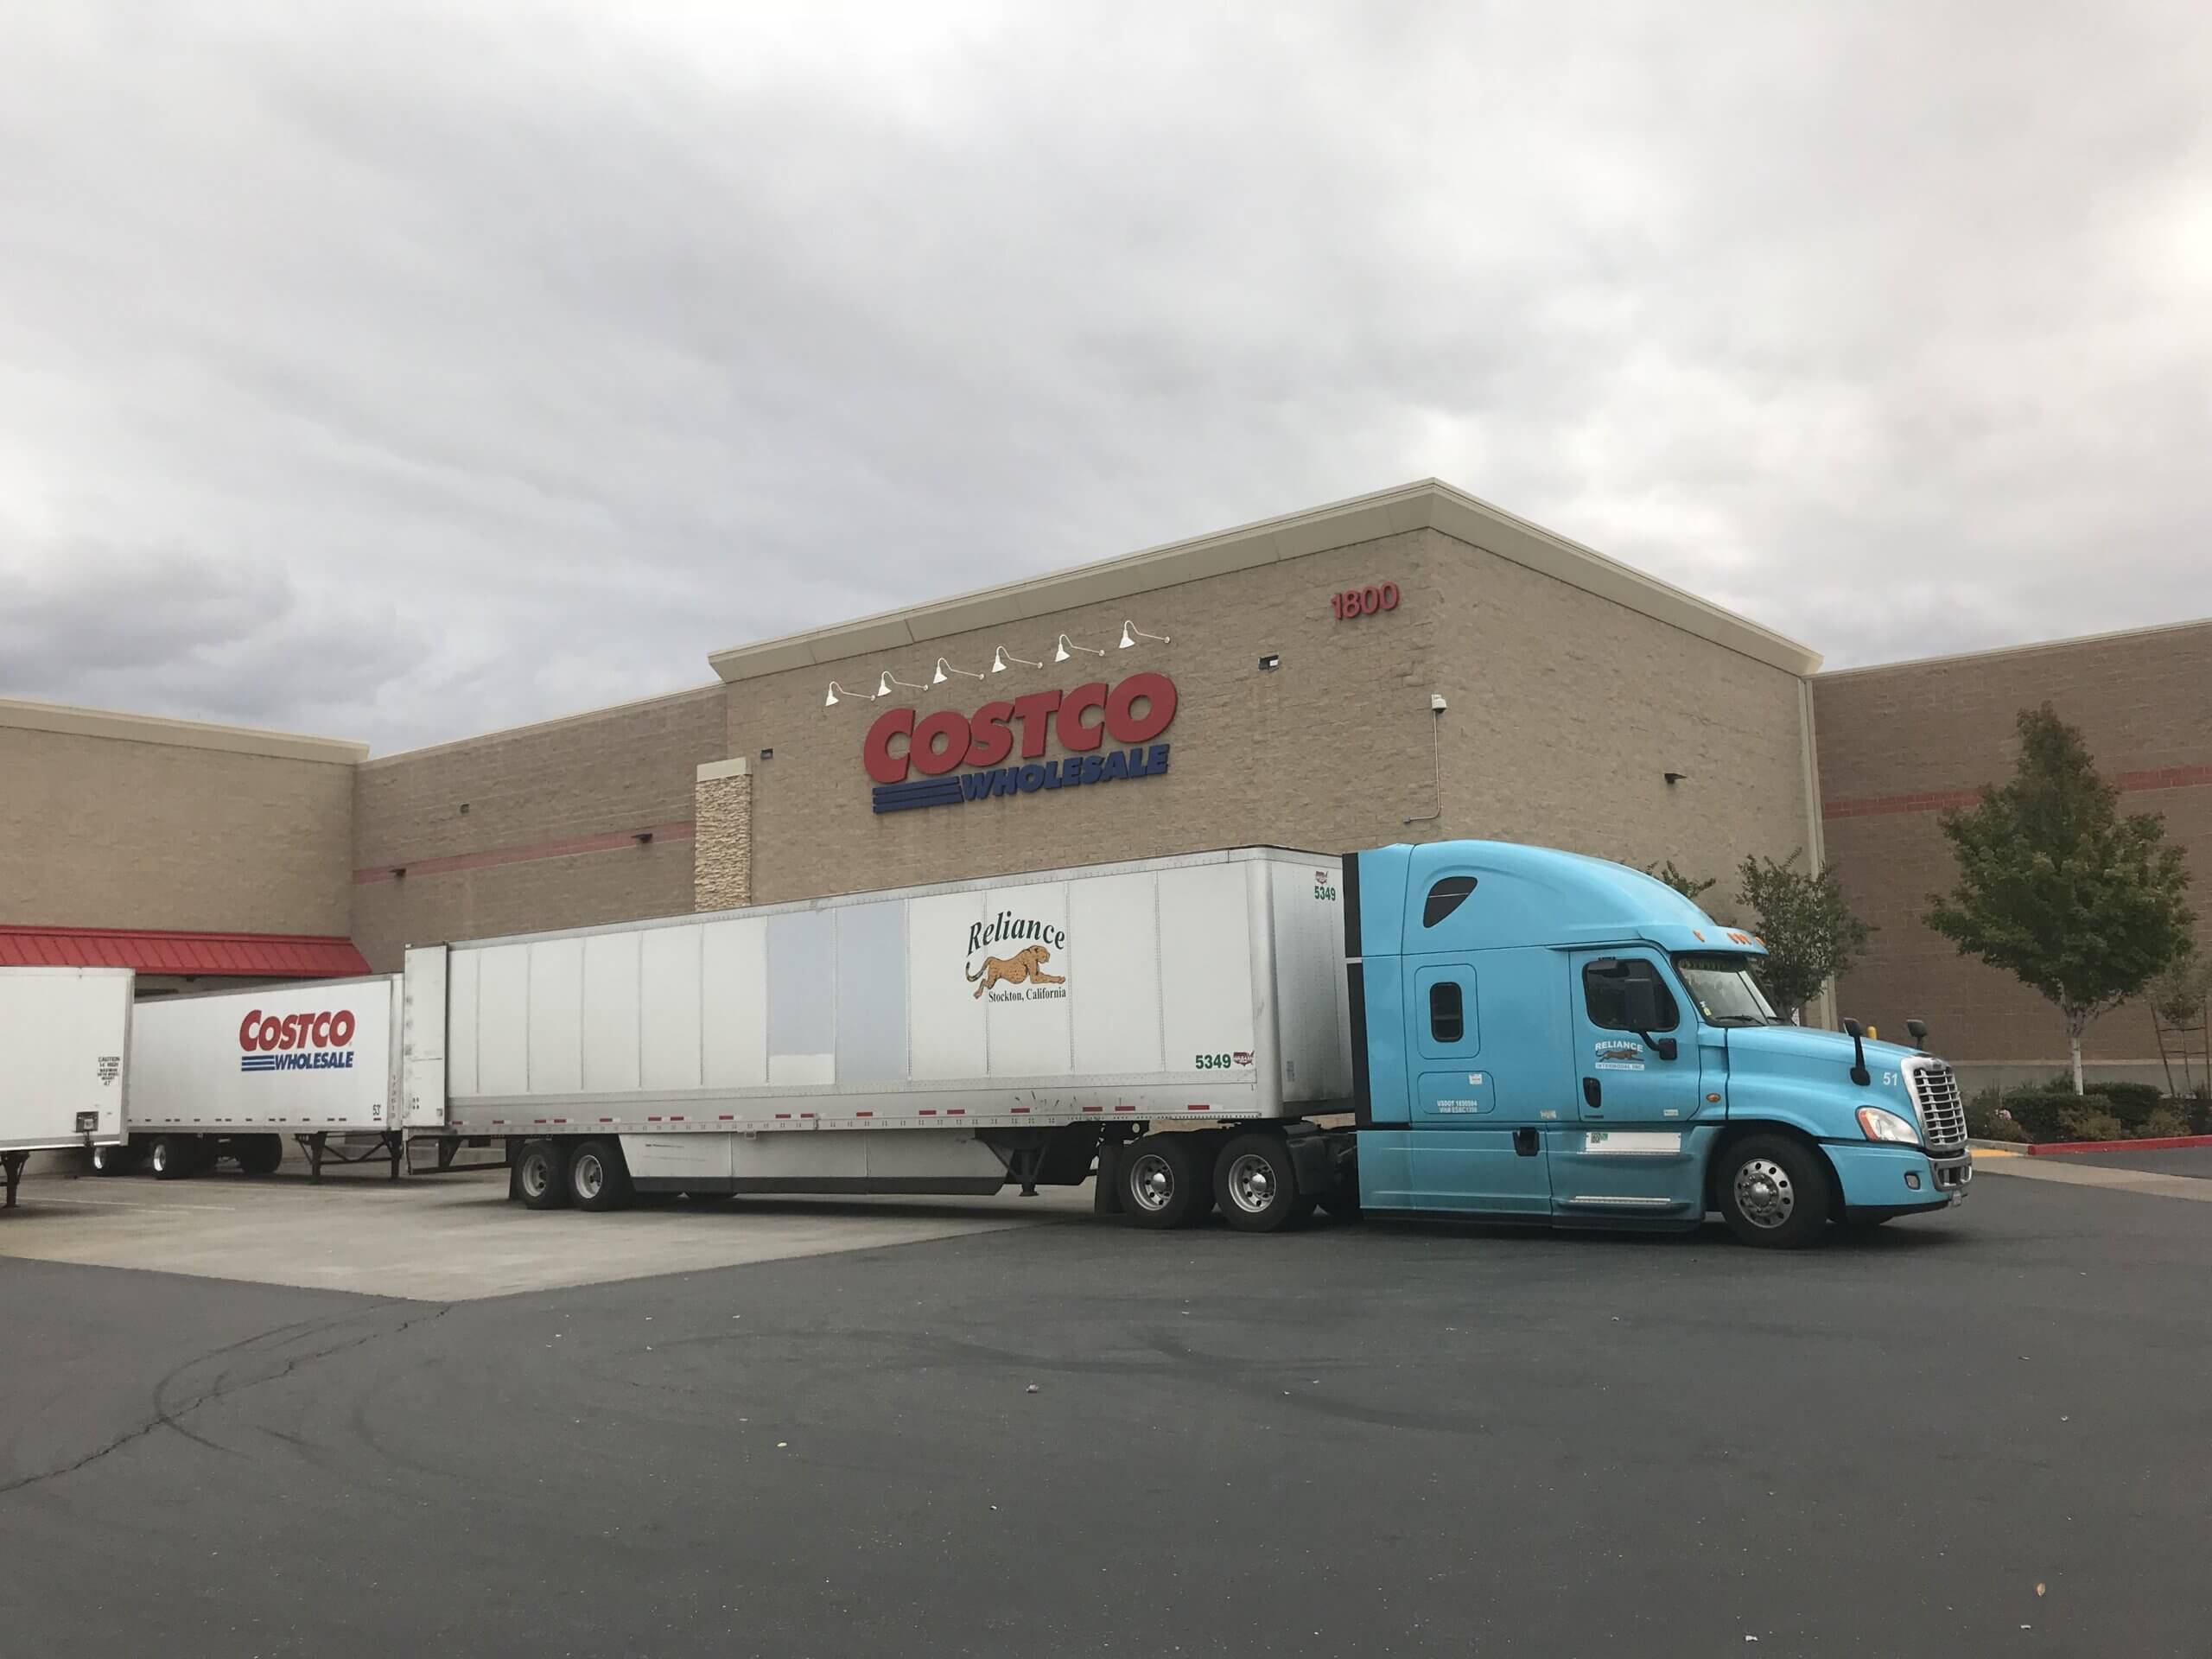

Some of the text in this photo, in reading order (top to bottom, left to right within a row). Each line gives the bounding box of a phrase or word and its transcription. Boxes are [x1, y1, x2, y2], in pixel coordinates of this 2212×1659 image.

[1332, 581, 1399, 620] 1800
[863, 671, 1178, 784] COSTCO
[959, 744, 1170, 801] WHOLESALE
[1314, 886, 1336, 901] 5349
[967, 911, 1065, 957] Reliance
[988, 987, 1067, 1003] Stockton, California
[239, 1009, 355, 1052] COSTCO
[1595, 1040, 1643, 1052] RELIANCE
[274, 1051, 354, 1071] WHOLESALE
[1195, 1053, 1231, 1069] 5349
[1883, 1071, 1898, 1086] 51
